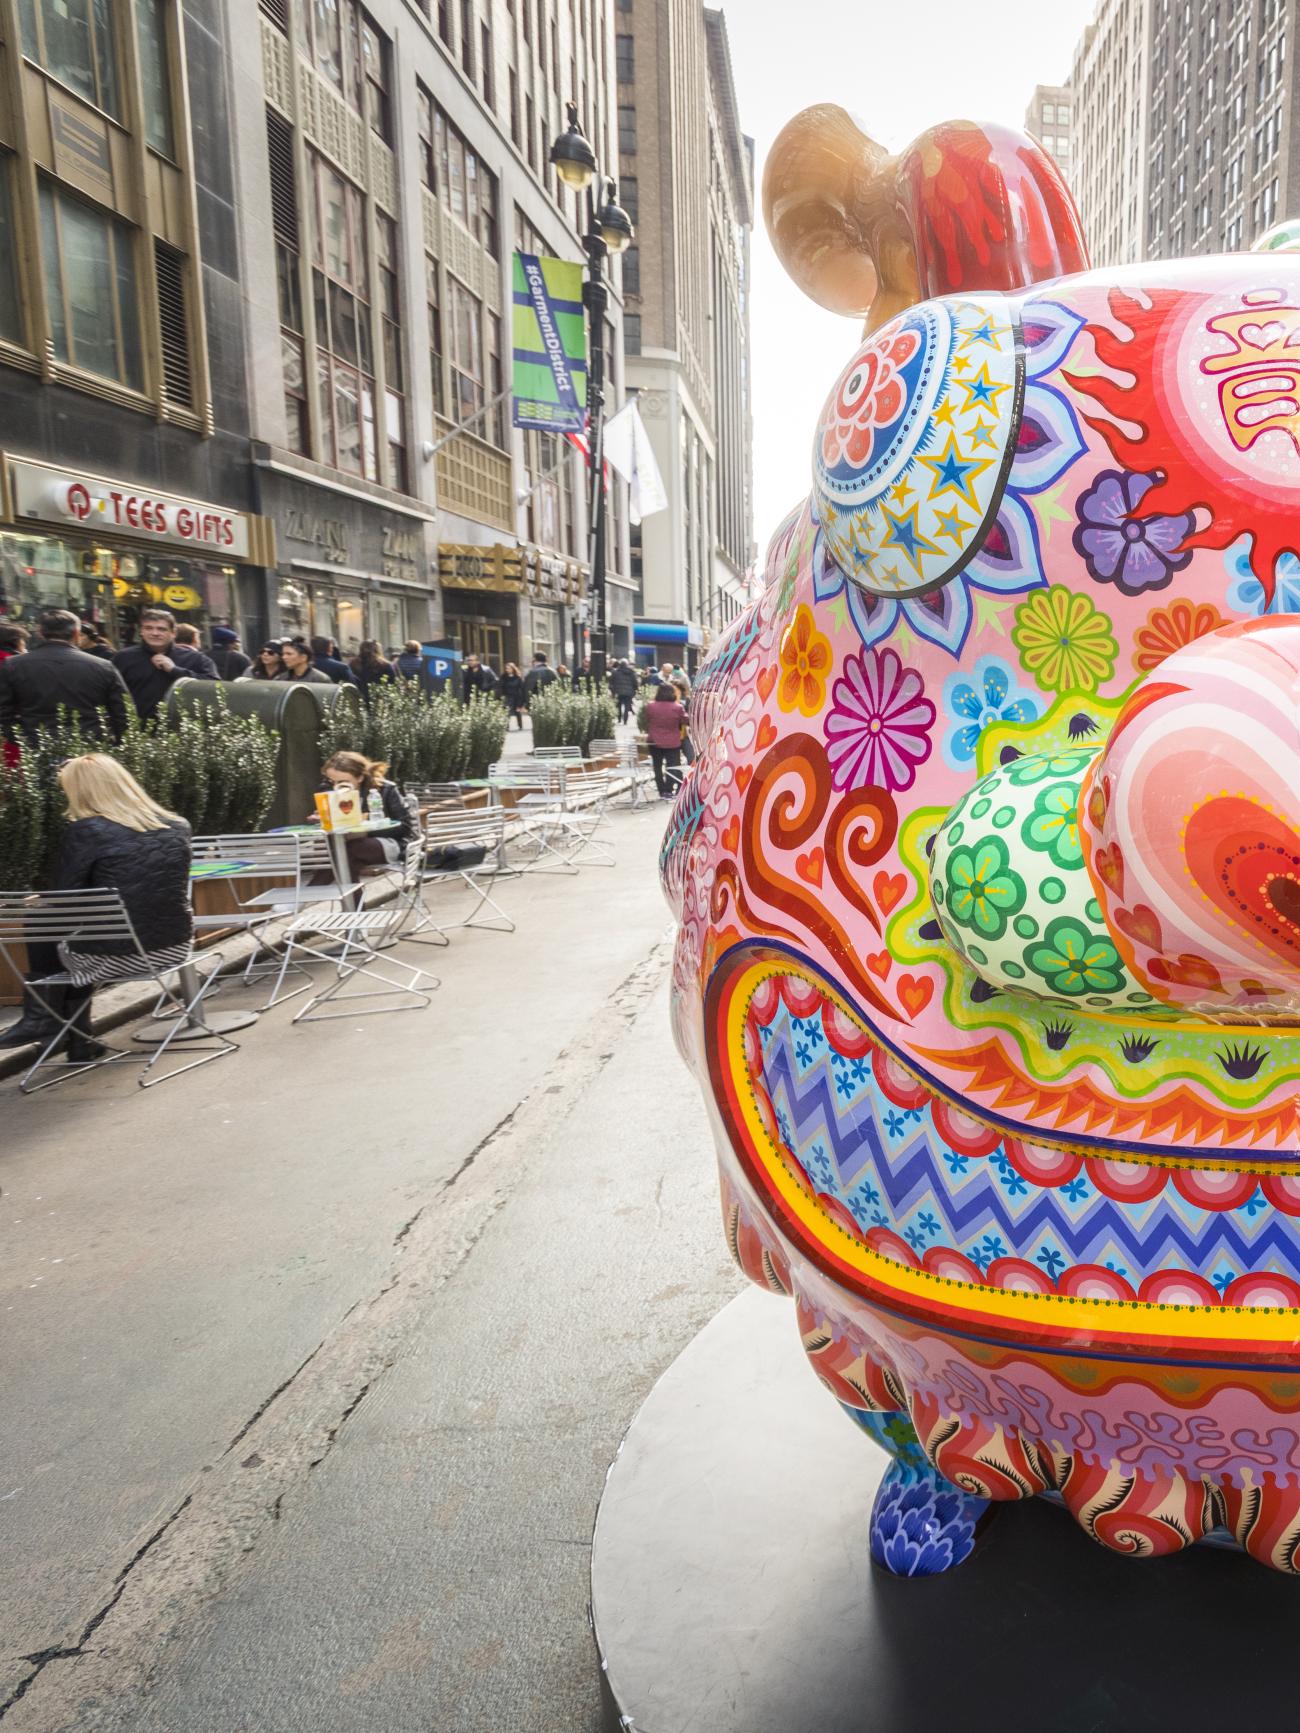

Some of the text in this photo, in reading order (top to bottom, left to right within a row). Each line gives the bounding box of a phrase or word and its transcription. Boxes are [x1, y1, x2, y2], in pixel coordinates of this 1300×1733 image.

[525, 264, 572, 392] #GarmentDistrict
[110, 491, 168, 533] TEES
[176, 508, 235, 545] GIFTS
[435, 660, 448, 676] P
